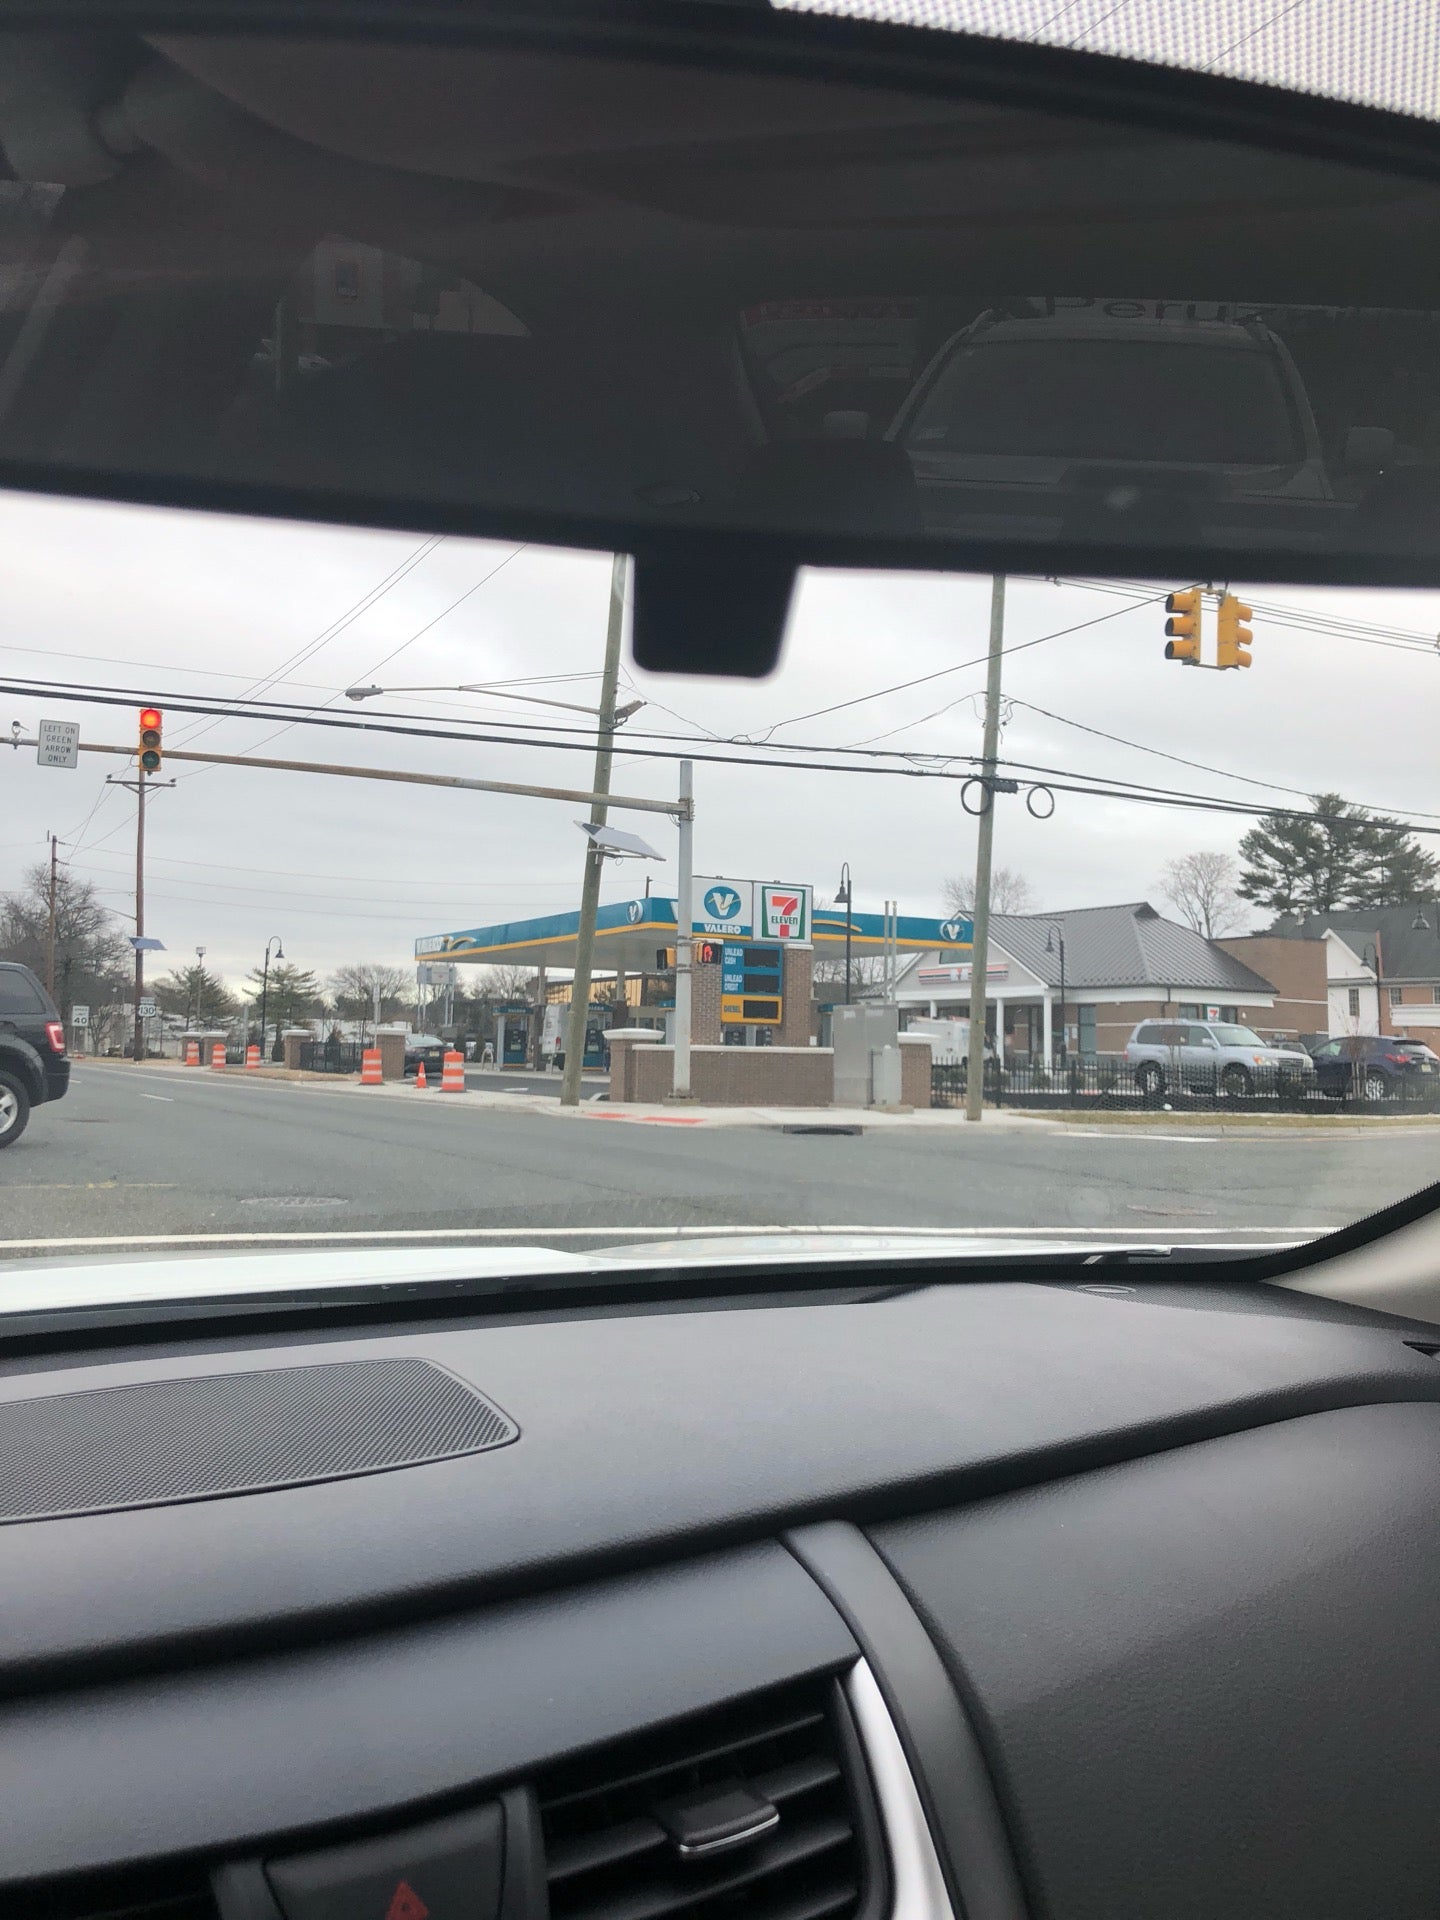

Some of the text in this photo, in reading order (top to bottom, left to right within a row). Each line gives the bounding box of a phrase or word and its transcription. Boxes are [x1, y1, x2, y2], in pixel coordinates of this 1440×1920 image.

[44, 724, 76, 735] LEFT ON
[46, 734, 72, 744] GREEN
[45, 745, 72, 754] ARROW
[47, 755, 67, 763] ONLY
[771, 895, 799, 938] 7
[703, 923, 742, 935] VALERO
[724, 947, 744, 957] UNLEAD
[724, 974, 743, 983] UNLEAD
[140, 1006, 155, 1016] 130
